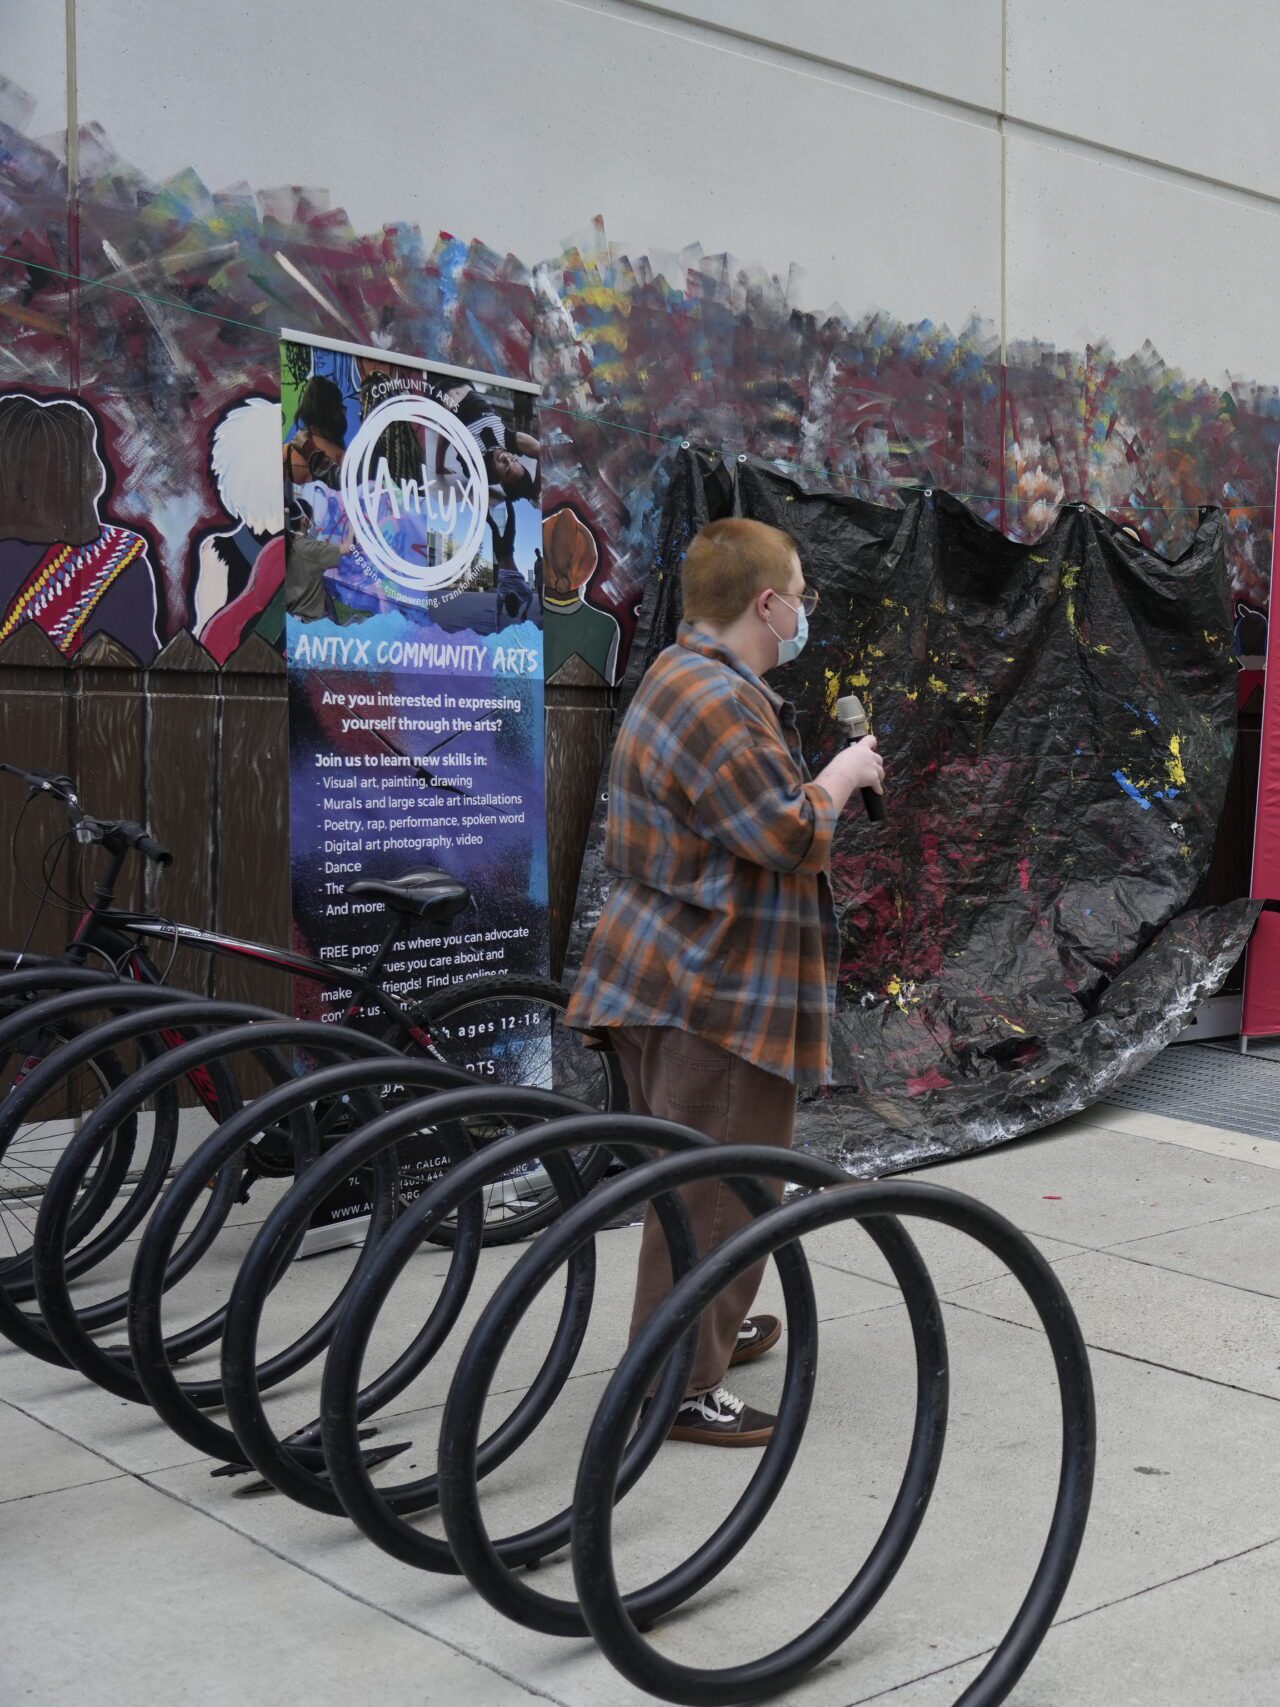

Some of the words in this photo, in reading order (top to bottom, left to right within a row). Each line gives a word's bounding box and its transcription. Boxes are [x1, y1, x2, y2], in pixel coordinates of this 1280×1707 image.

[371, 378, 435, 398] COMMUNITY
[437, 389, 459, 414] ARTS
[367, 456, 480, 535] Antyx
[295, 634, 368, 666] ANTYX
[377, 640, 487, 670] COMMUNITY
[493, 647, 538, 674] ARTS
[322, 691, 345, 704] Are
[348, 694, 374, 708] you
[378, 692, 441, 707] interested
[444, 694, 456, 707] in
[458, 696, 521, 712] expressing
[342, 716, 396, 733] yourself
[398, 717, 449, 733] through
[452, 718, 473, 731] the
[474, 719, 502, 731] arts?
[315, 753, 342, 767] Join
[345, 756, 361, 767] us
[365, 754, 378, 766] to
[381, 753, 410, 766] learn
[413, 756, 440, 766] new
[442, 753, 471, 766] skills
[474, 753, 487, 766] in:
[323, 776, 357, 788] Visual
[360, 776, 379, 788] art,
[382, 775, 428, 790] painting,
[430, 774, 473, 789] drawing
[324, 797, 362, 810] Murals
[365, 796, 386, 809] and
[388, 796, 415, 810] large
[417, 795, 444, 807] scale
[446, 795, 461, 806] art
[463, 793, 522, 806] installations
[324, 820, 364, 832] Poetry,
[367, 820, 387, 832] rap,
[390, 816, 460, 831] performance,
[461, 813, 497, 828] spoken
[498, 812, 525, 824] word
[325, 839, 362, 854] Digital
[365, 839, 381, 851] art
[383, 835, 454, 852] photography,
[456, 833, 483, 845] video
[325, 862, 362, 874] Dance
[325, 882, 345, 895] The
[326, 902, 348, 916] And
[320, 945, 348, 959] FREE
[408, 937, 441, 950] where
[443, 935, 462, 948] you
[464, 933, 482, 943] can
[485, 927, 529, 941] advocate
[407, 959, 427, 973] you
[429, 955, 452, 967] care
[454, 950, 484, 964] about
[486, 947, 504, 960] and
[321, 987, 352, 1002] make
[382, 978, 422, 993] friends!
[426, 973, 449, 988] Find
[452, 974, 463, 983] us
[368, 1006, 380, 1016] us
[458, 1022, 494, 1038] ages
[501, 1013, 540, 1029] 12-18
